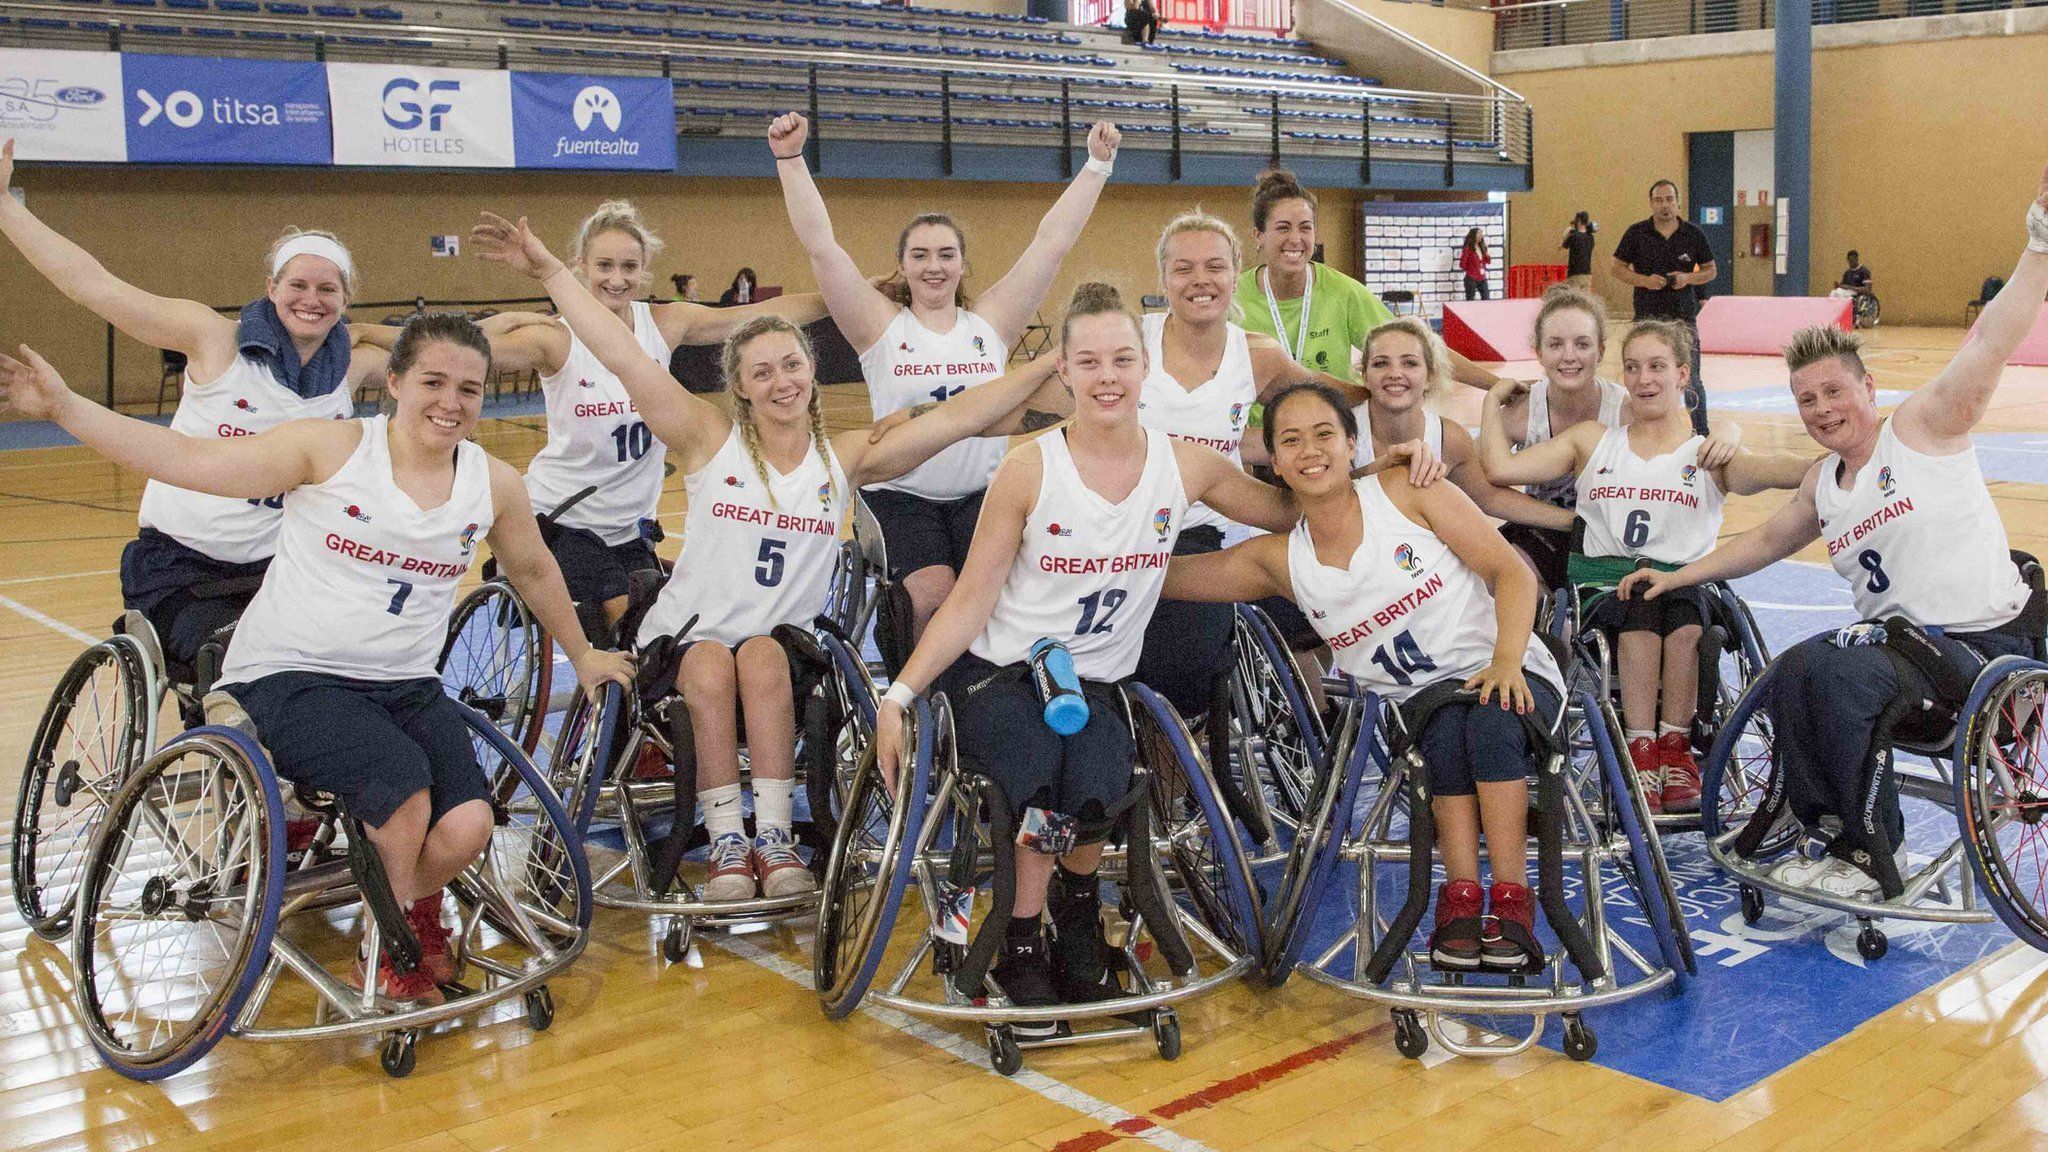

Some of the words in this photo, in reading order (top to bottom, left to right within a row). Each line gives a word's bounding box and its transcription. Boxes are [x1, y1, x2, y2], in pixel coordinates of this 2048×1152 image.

[212, 97, 281, 126] titsa
[382, 77, 460, 132] GF
[383, 137, 464, 154] HOTELES
[554, 137, 640, 157] fuentealta
[1705, 207, 1719, 224] B
[1309, 328, 1330, 340] Staff
[894, 364, 942, 376] GREAT
[946, 362, 998, 375] BRITAIN
[574, 401, 625, 417] GREAT
[611, 421, 652, 462] 10
[1589, 486, 1636, 500] GREAT
[1640, 488, 1699, 509] BRITAIN
[712, 502, 773, 526] GREAT
[777, 514, 835, 536] BRITAIN
[1623, 509, 1651, 548] 6
[1853, 497, 1914, 541] BRITAIN
[325, 533, 400, 567] GREAT
[401, 557, 468, 579] BRITAIN
[755, 537, 787, 587] 5
[1040, 555, 1108, 574] GREAT
[1858, 548, 1891, 594] 8
[387, 578, 413, 616] 7
[1074, 588, 1128, 635] 12
[1328, 620, 1374, 651] REAT
[1373, 573, 1444, 628] BRITAIN
[1370, 629, 1438, 686] 14
